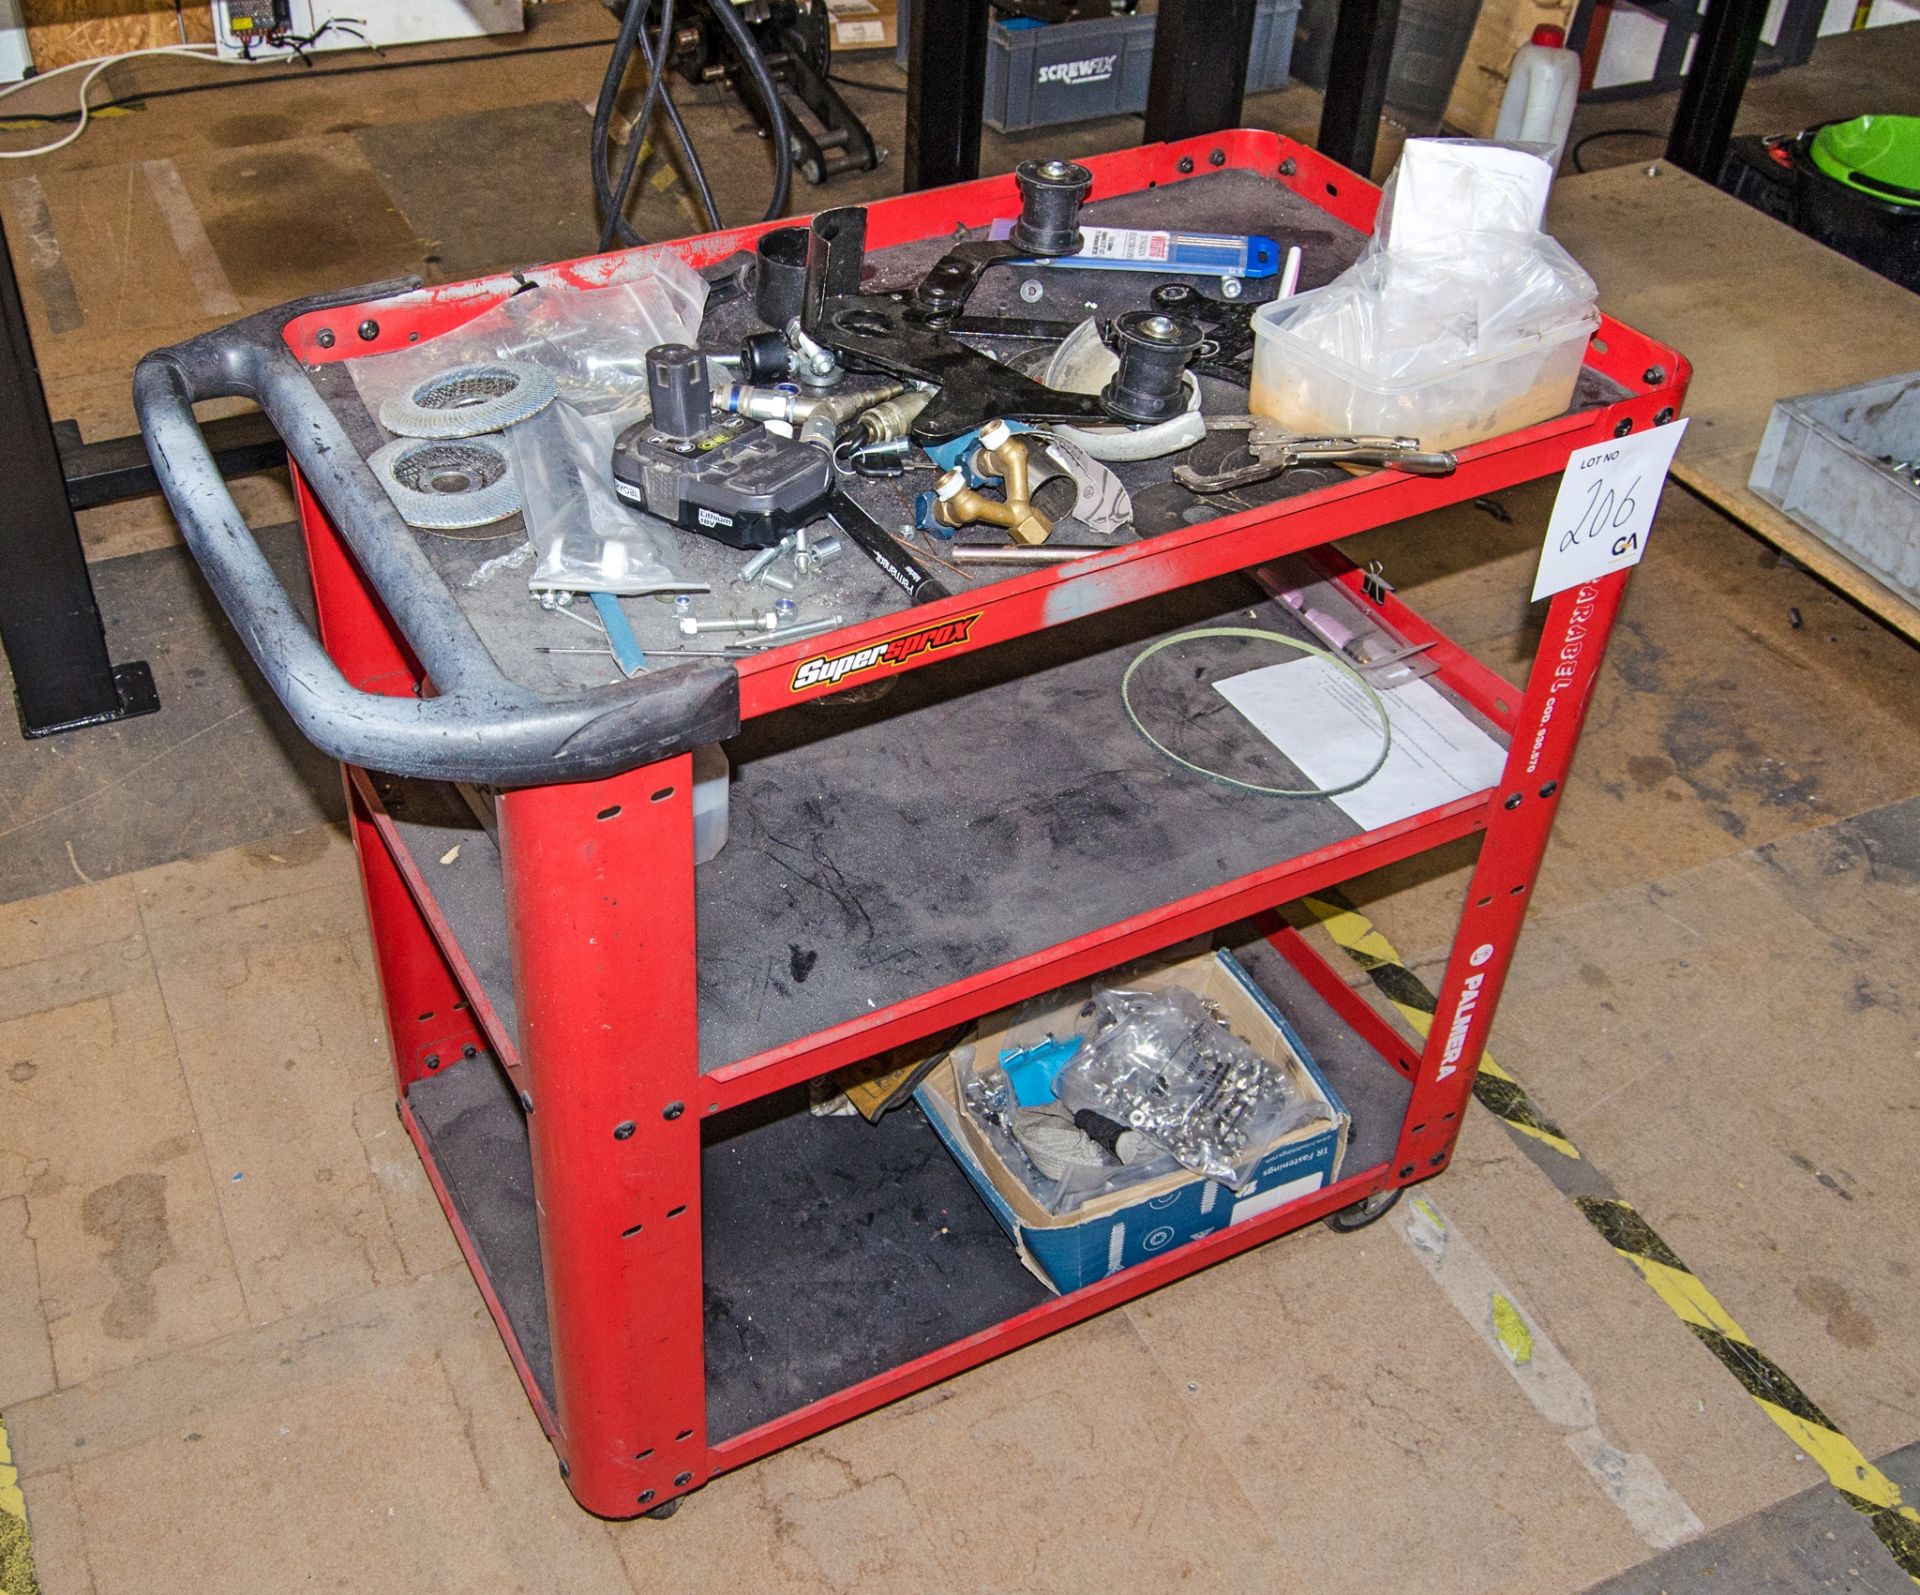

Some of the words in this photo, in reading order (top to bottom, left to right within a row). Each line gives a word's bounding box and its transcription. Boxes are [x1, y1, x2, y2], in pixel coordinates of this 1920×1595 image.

[1038, 55, 1117, 84] SCREWFIX
[1580, 455, 1601, 470] LOT
[1603, 450, 1620, 464] NO
[700, 510, 732, 525] Lithium
[1559, 475, 1642, 553] 206
[1551, 578, 1600, 694] ARABEL
[793, 616, 982, 690] Supersprox
[1436, 973, 1485, 1082] PALMERA
[1263, 1152, 1315, 1177] Fastenings
[1316, 1146, 1328, 1158] TR
